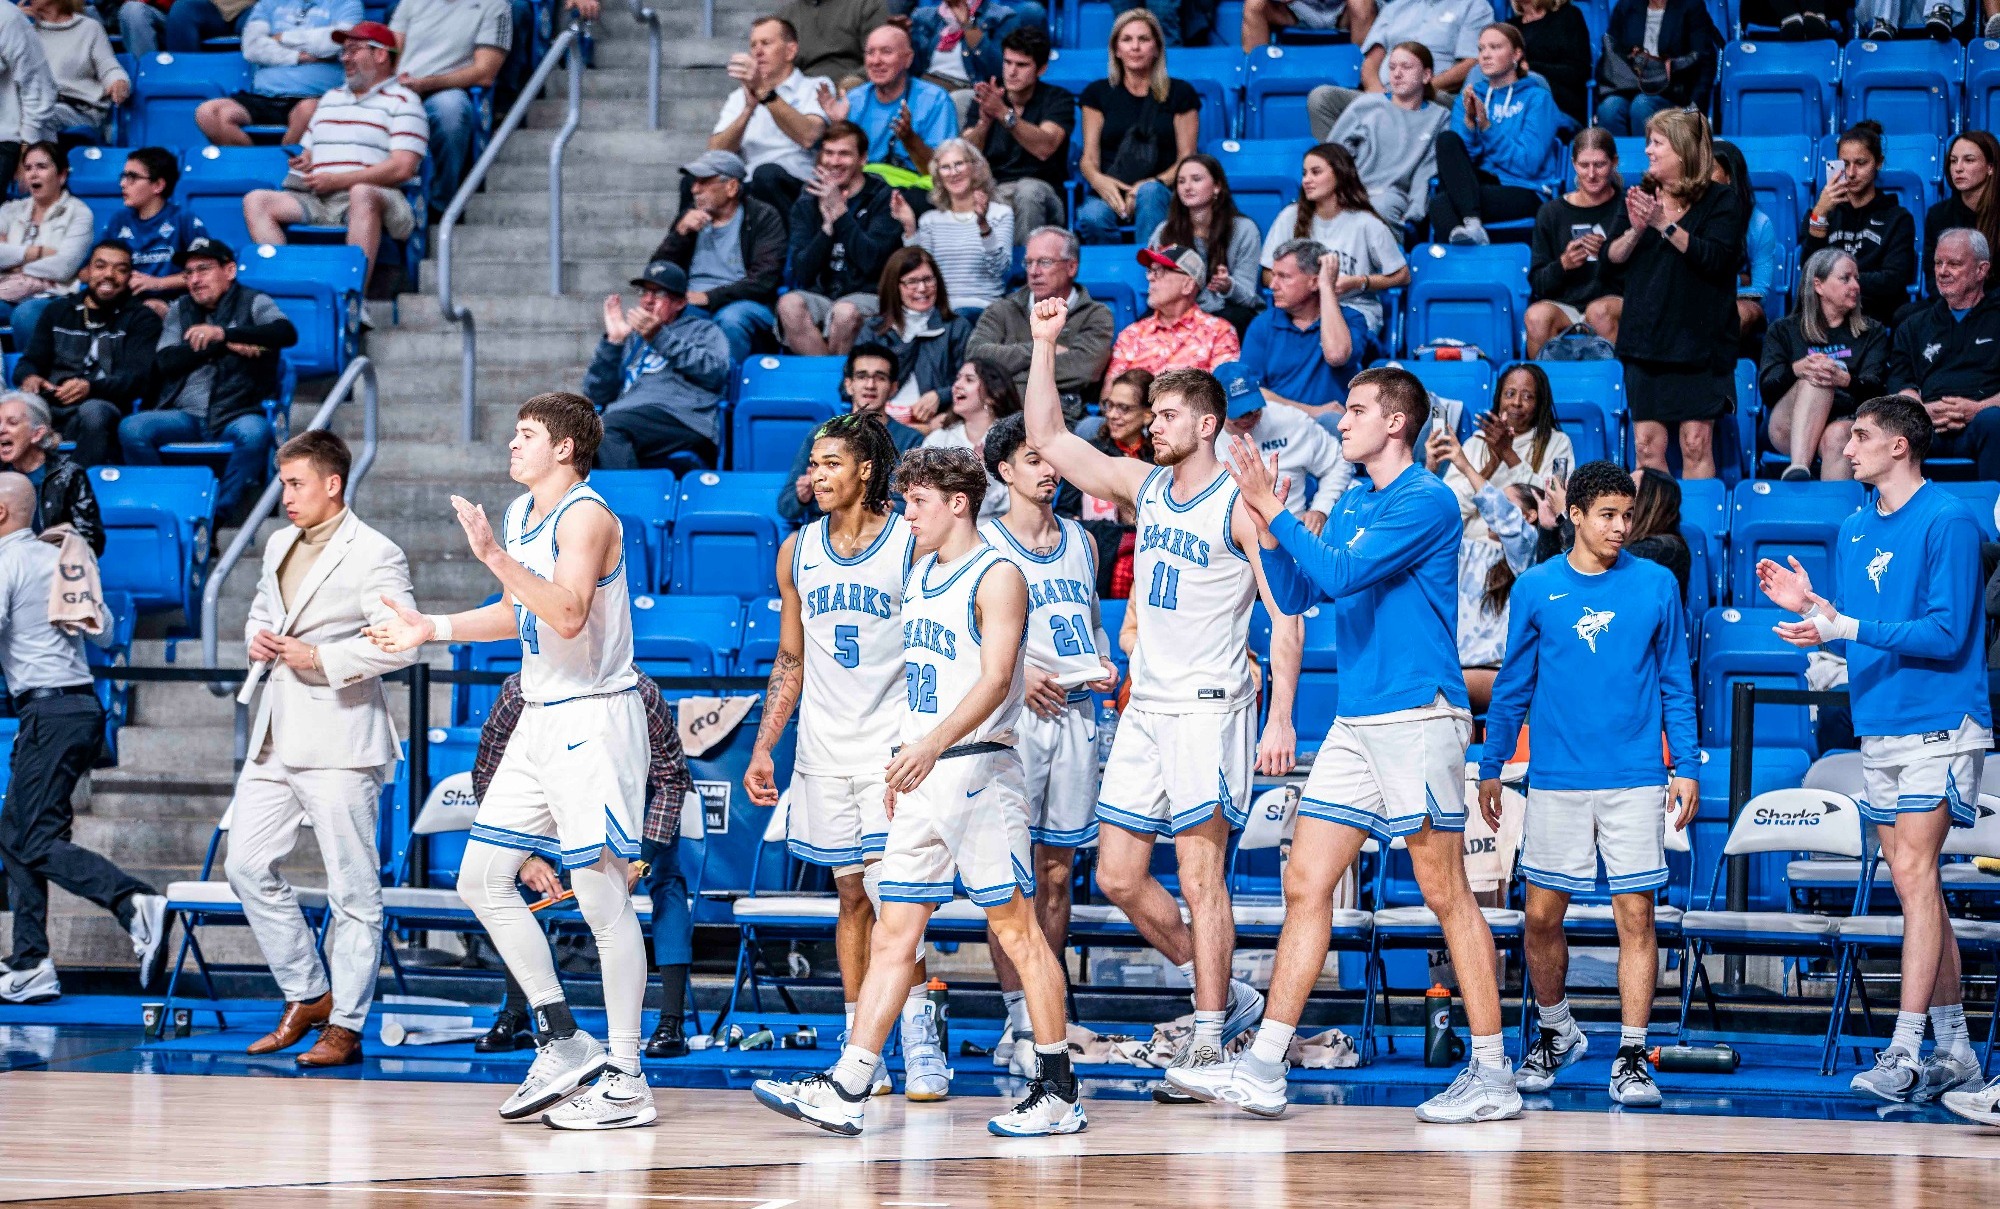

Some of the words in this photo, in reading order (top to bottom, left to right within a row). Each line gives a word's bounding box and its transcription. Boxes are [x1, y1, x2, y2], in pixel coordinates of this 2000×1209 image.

[1261, 437, 1288, 453] NSU
[1139, 523, 1211, 569] SHARKS
[807, 582, 892, 620] SHARKS
[1148, 560, 1181, 611] 11
[833, 624, 860, 669] 5
[903, 618, 957, 661] HARKS
[1049, 613, 1096, 657] 21
[905, 661, 938, 714] 32
[442, 790, 477, 806] Sha
[1753, 808, 1821, 826] Sharks
